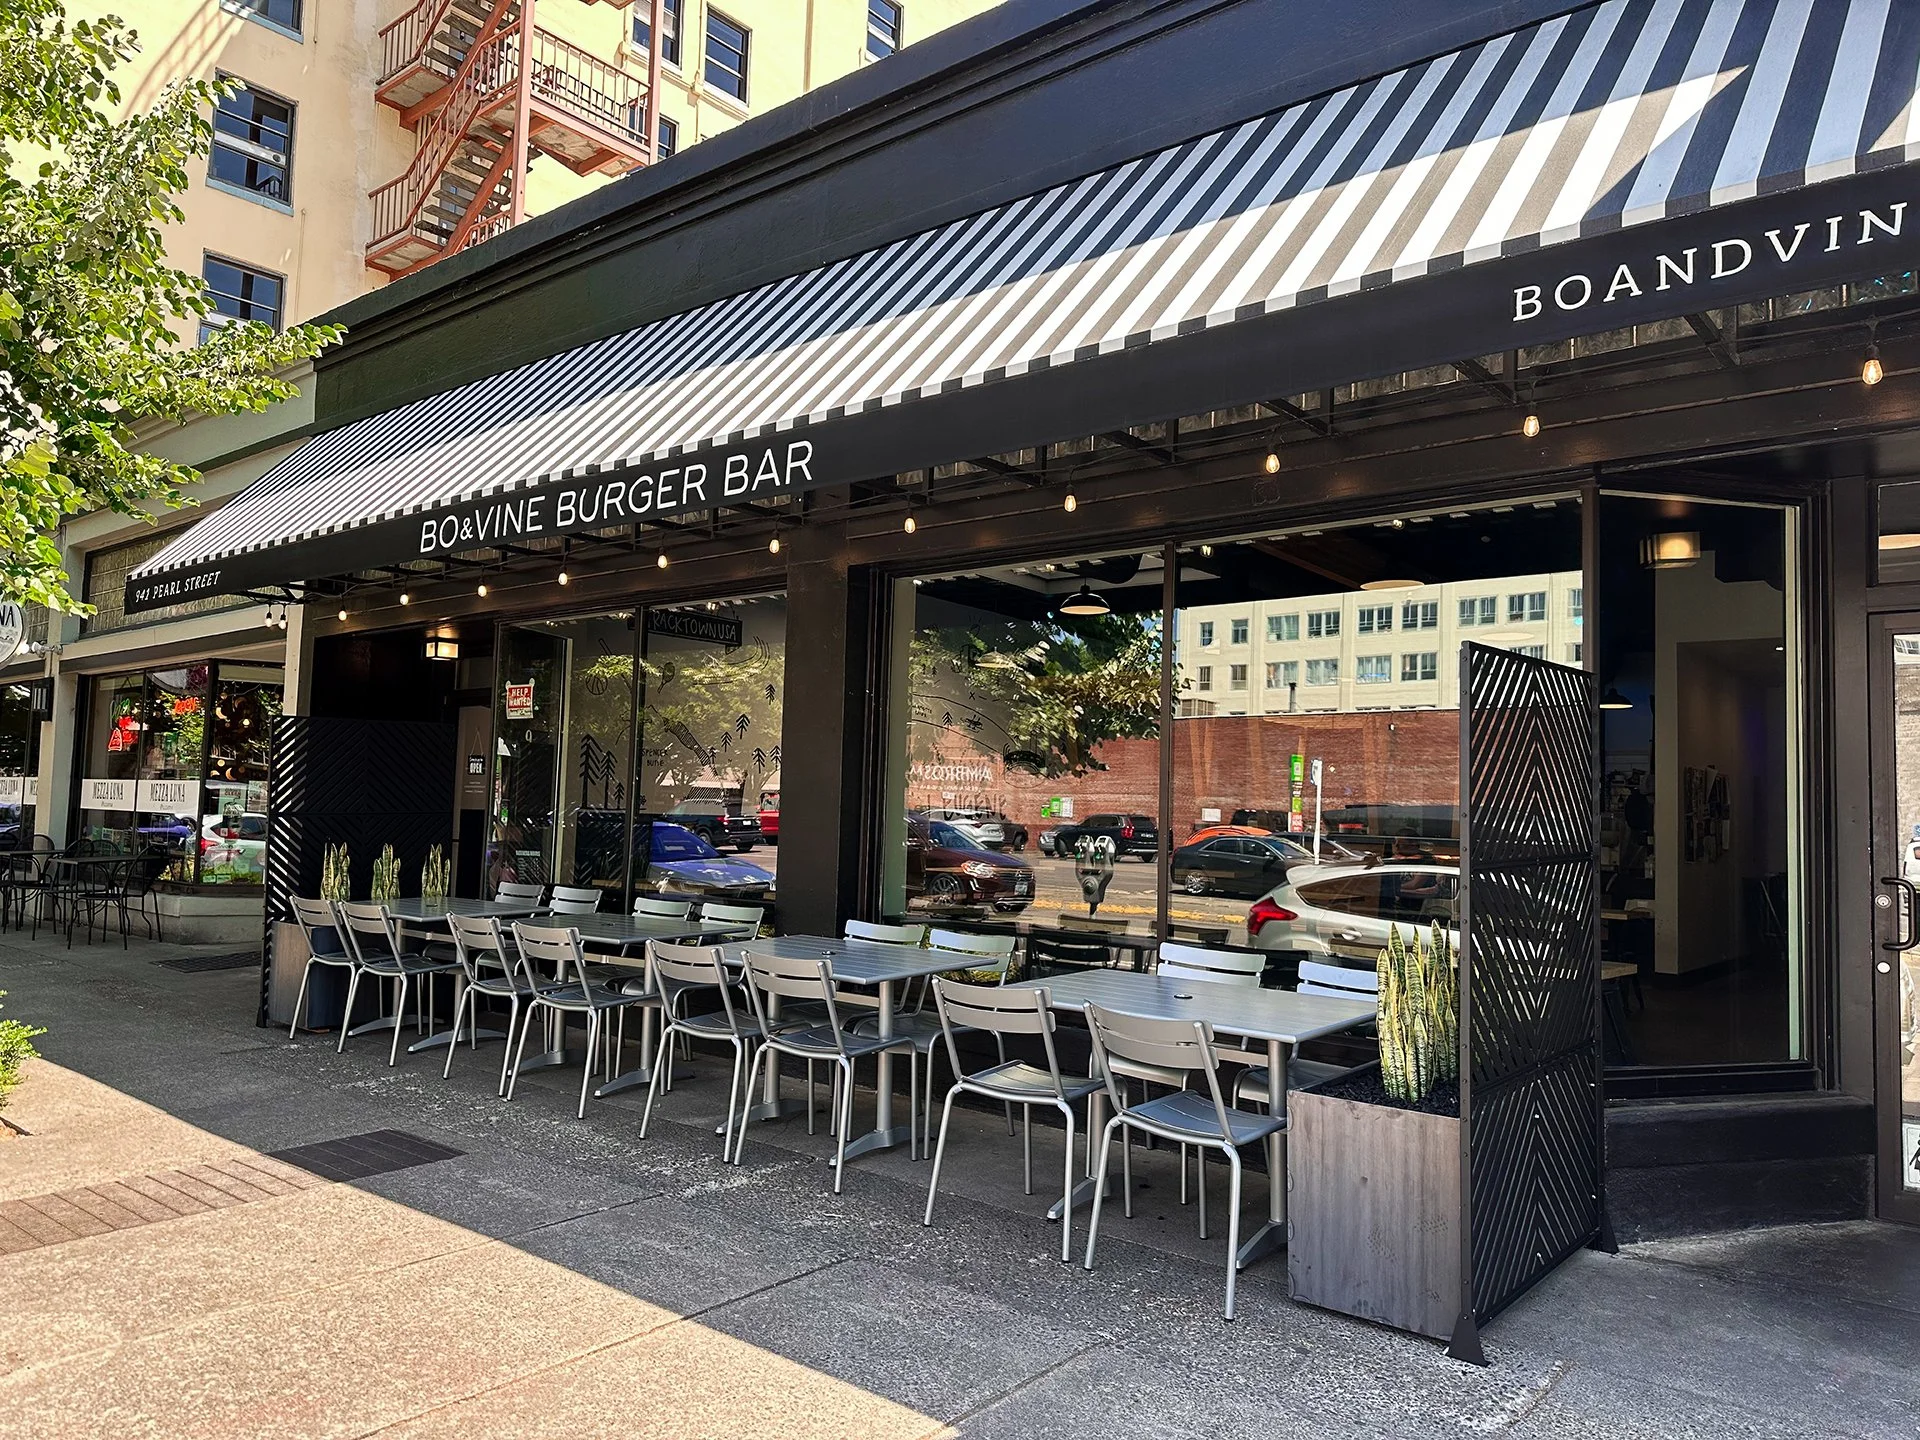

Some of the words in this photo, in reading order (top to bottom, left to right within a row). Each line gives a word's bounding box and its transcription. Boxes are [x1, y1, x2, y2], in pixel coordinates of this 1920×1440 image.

[1512, 201, 1908, 322] BOANDVIN
[419, 495, 546, 553] BO&VINE
[556, 462, 707, 528] BURGER
[723, 440, 813, 497] BAR
[135, 588, 151, 603] 941
[152, 580, 181, 599] PEARL
[184, 571, 221, 592] STREET
[508, 697, 531, 707] WANTED
[511, 688, 530, 697] HELP
